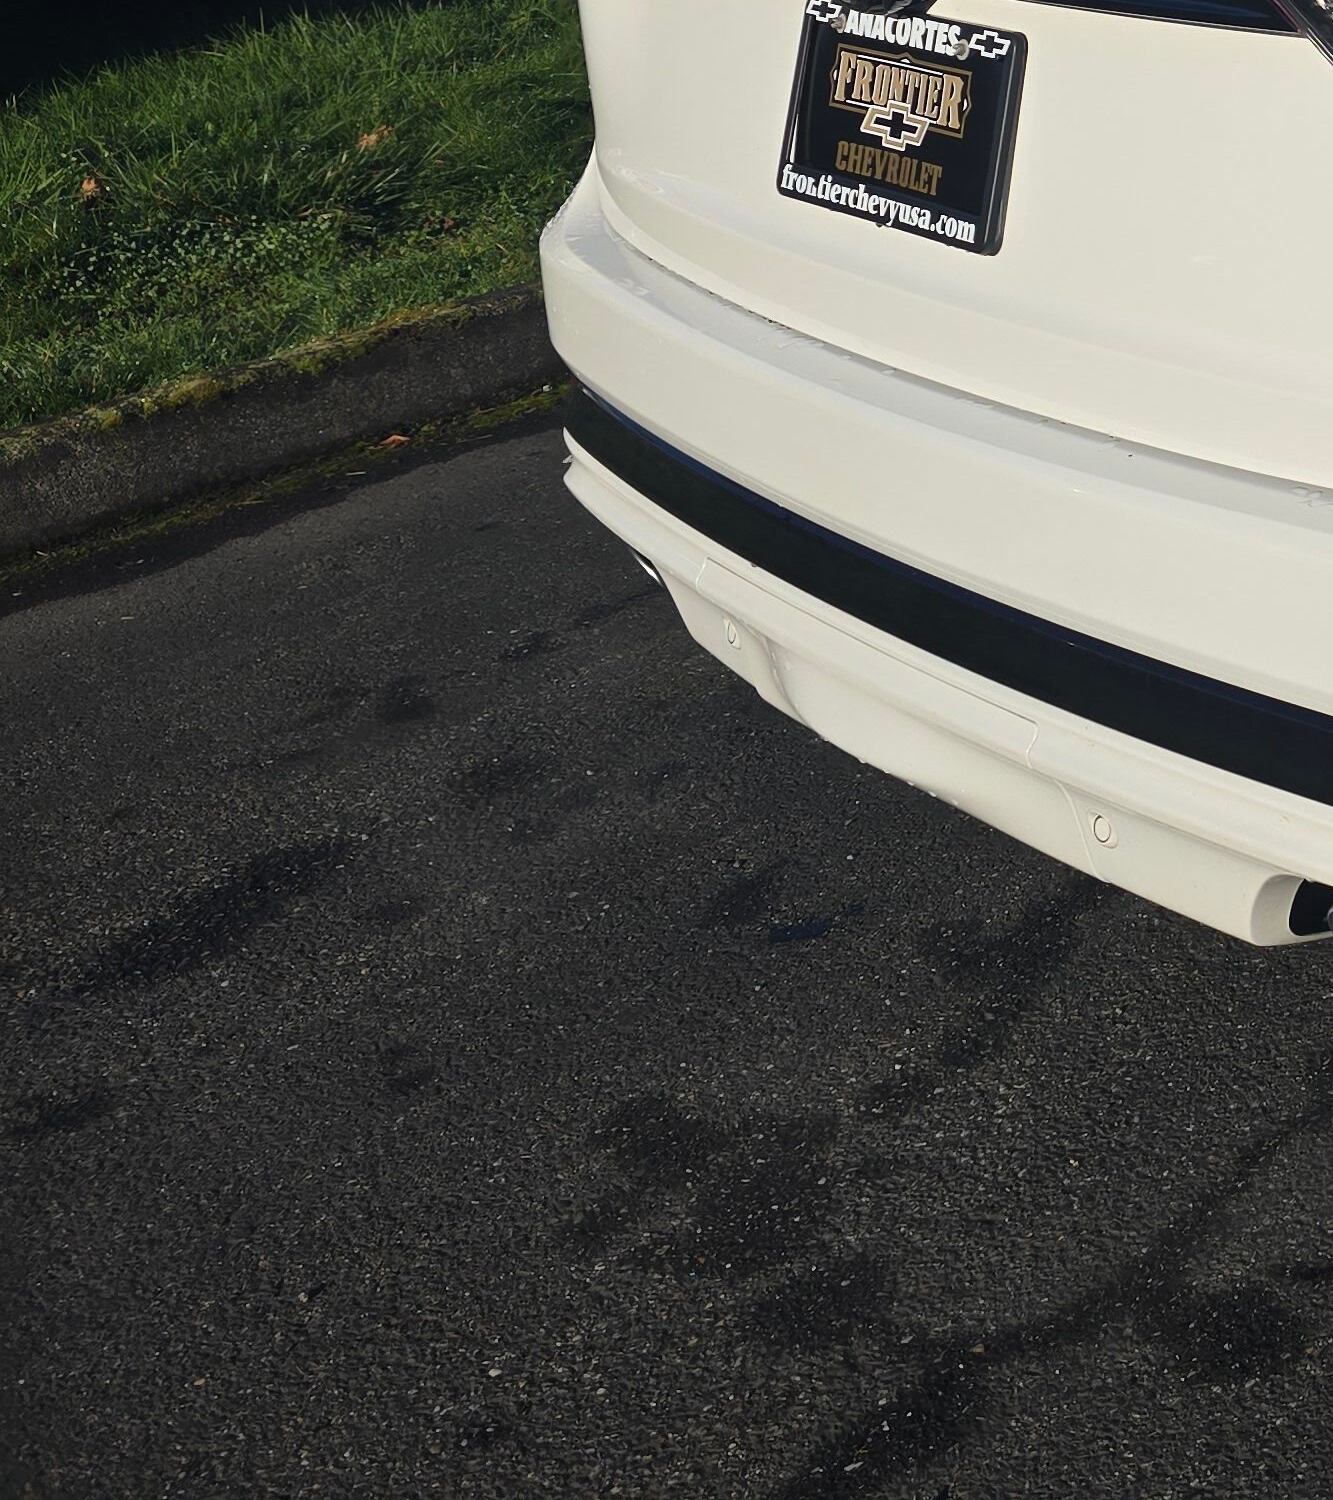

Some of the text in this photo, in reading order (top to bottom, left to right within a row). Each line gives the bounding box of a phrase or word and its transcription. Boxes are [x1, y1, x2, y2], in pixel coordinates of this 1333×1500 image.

[844, 9, 962, 56] ANACORTES
[834, 51, 964, 129] FRONTIER
[836, 140, 942, 196] CHEVROLET
[780, 164, 976, 244] frontierchevyusa.com
